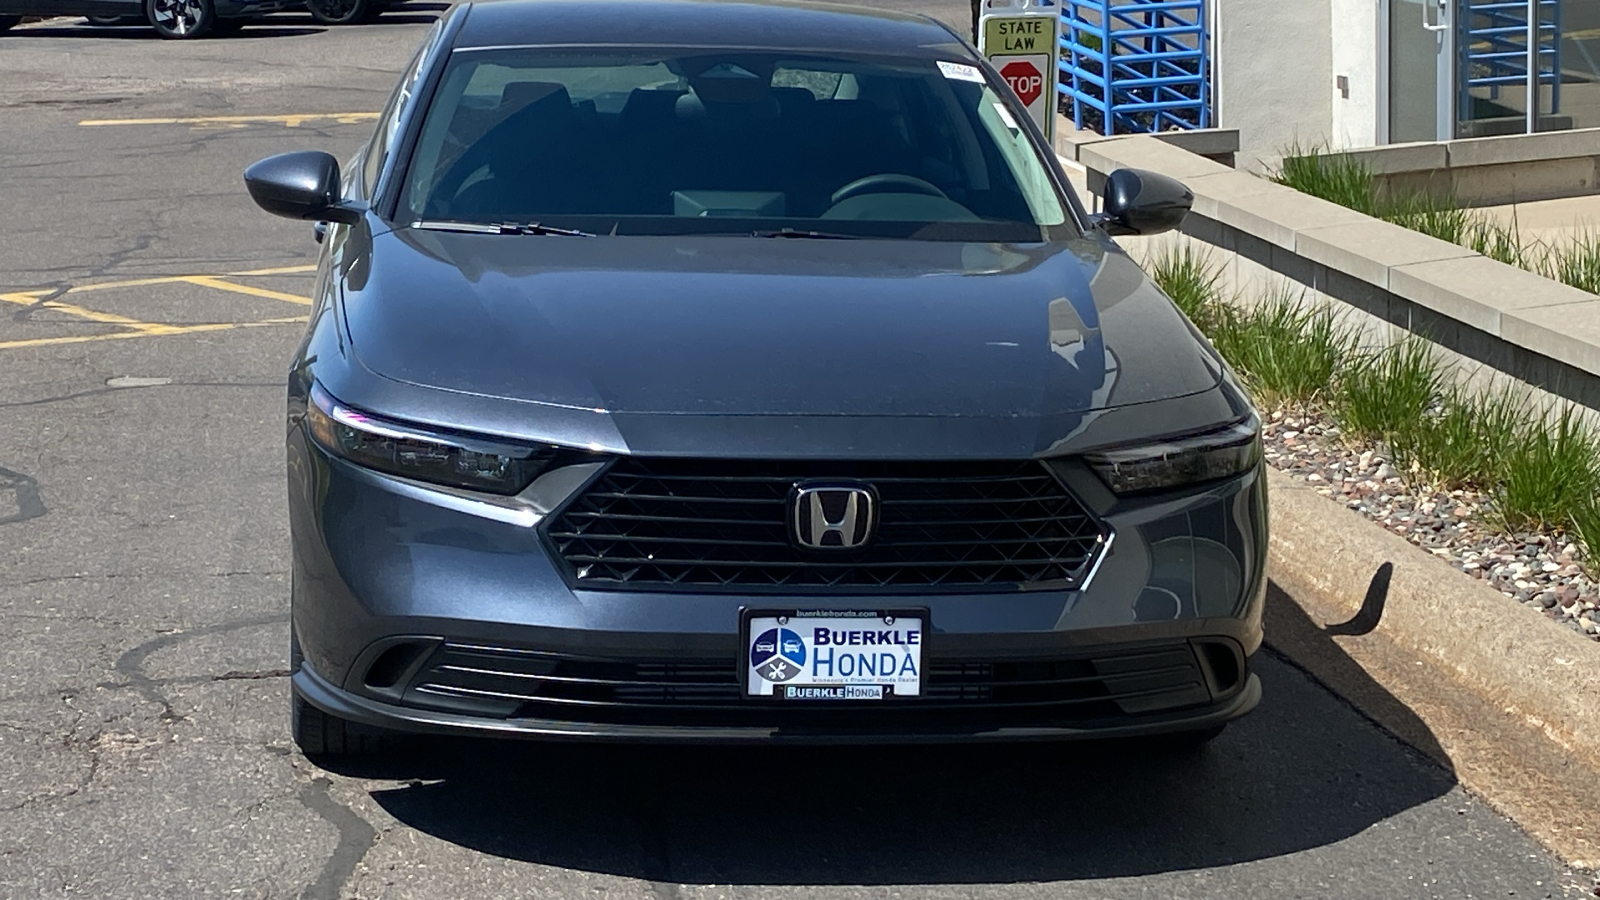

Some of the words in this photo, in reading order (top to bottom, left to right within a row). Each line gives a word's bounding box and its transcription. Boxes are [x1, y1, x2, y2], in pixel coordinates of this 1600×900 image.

[999, 21, 1042, 35] STATE
[1005, 37, 1035, 50] LAW
[1007, 76, 1042, 94] TOP
[796, 609, 877, 618] buerklehonda.com
[814, 627, 920, 646] BUERKLE
[812, 647, 918, 677] HONDA
